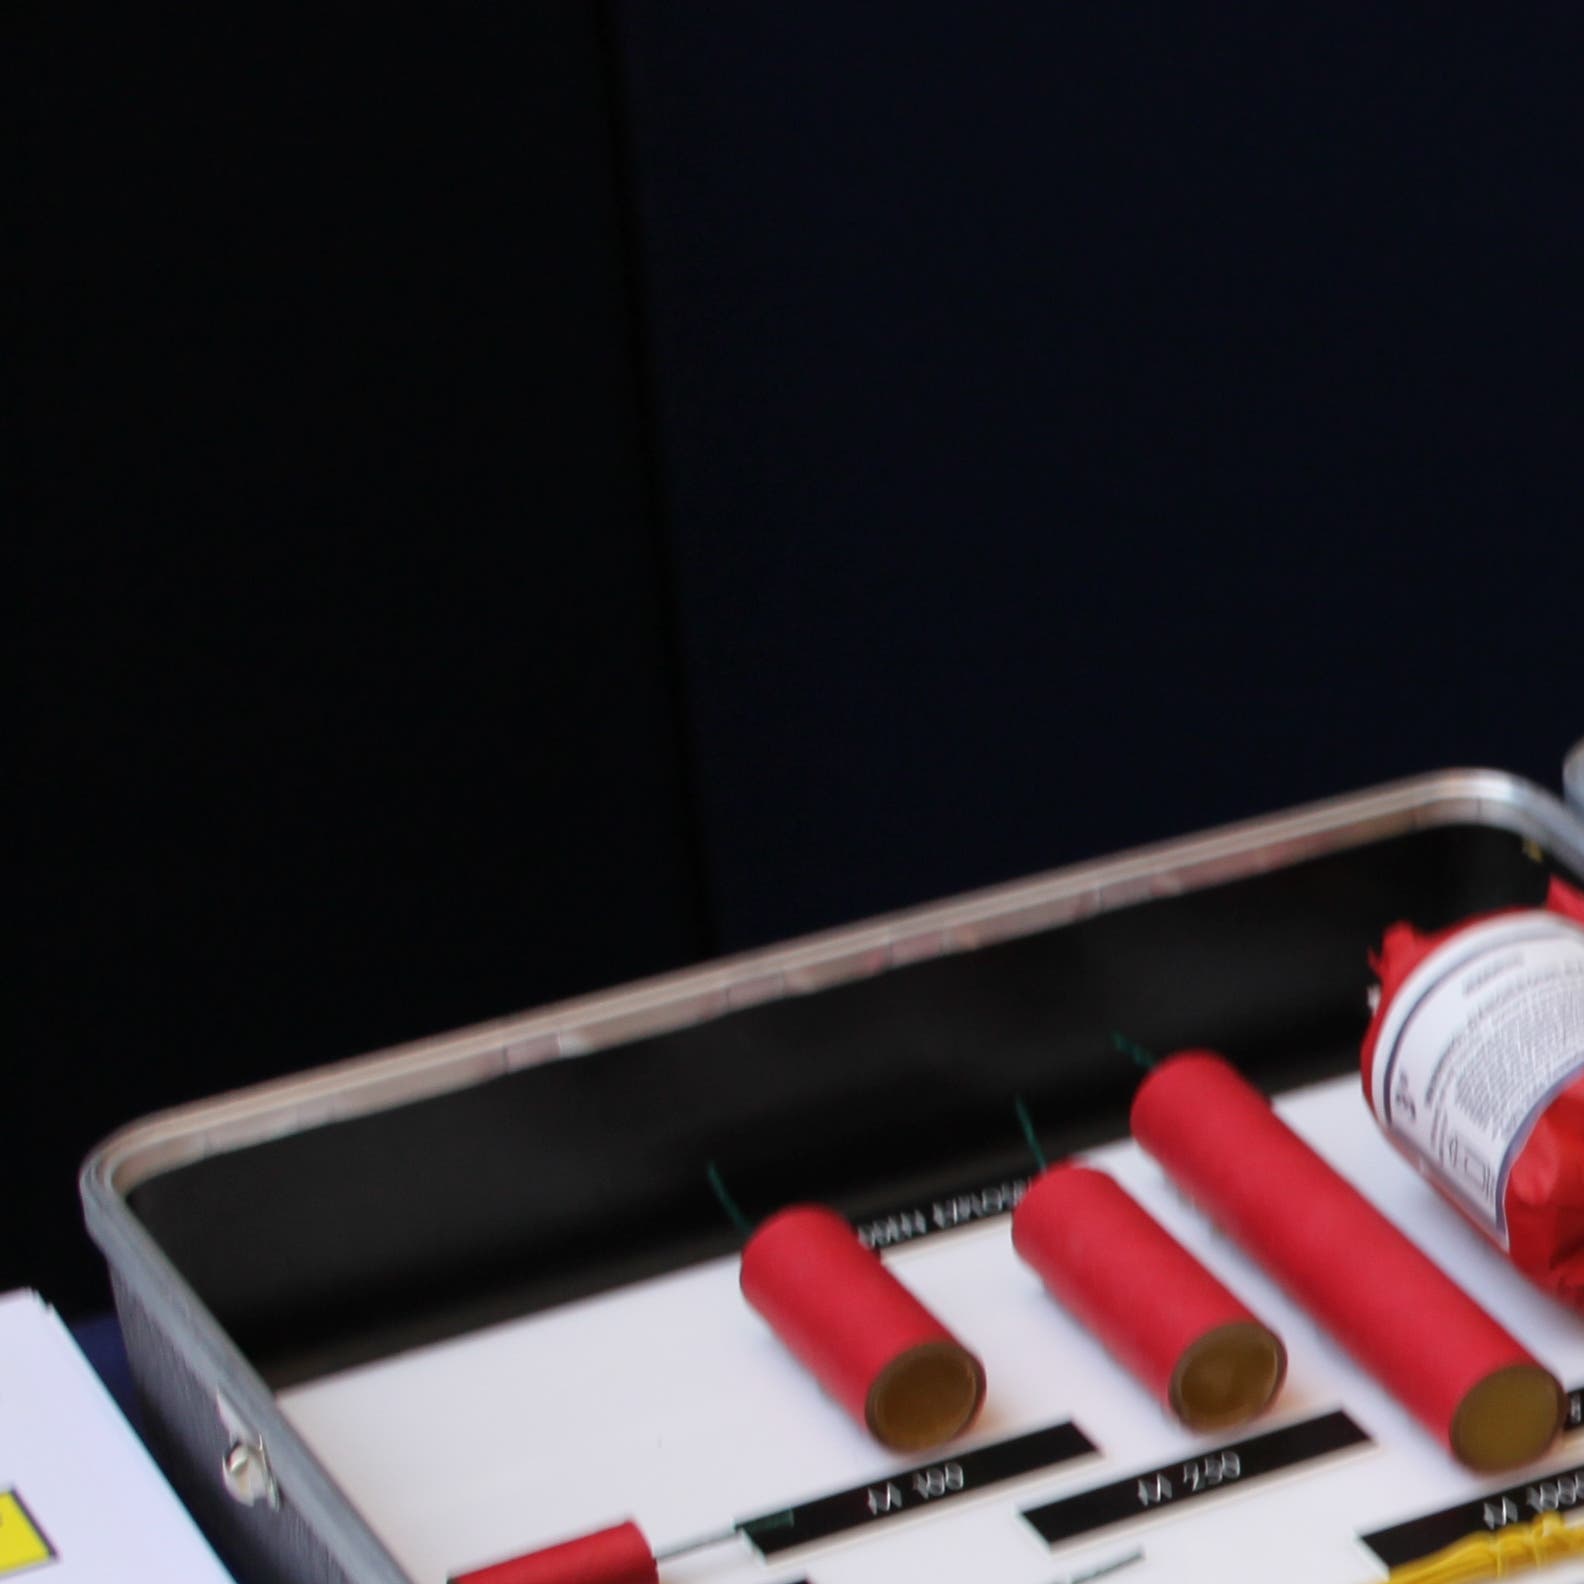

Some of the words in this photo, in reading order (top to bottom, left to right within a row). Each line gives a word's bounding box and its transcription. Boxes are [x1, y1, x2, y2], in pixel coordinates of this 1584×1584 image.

[866, 1480, 904, 1517] M
[912, 1461, 965, 1501] 100
[1137, 1472, 1173, 1508] M
[1182, 1449, 1242, 1493] 250
[1482, 1494, 1519, 1532] M
